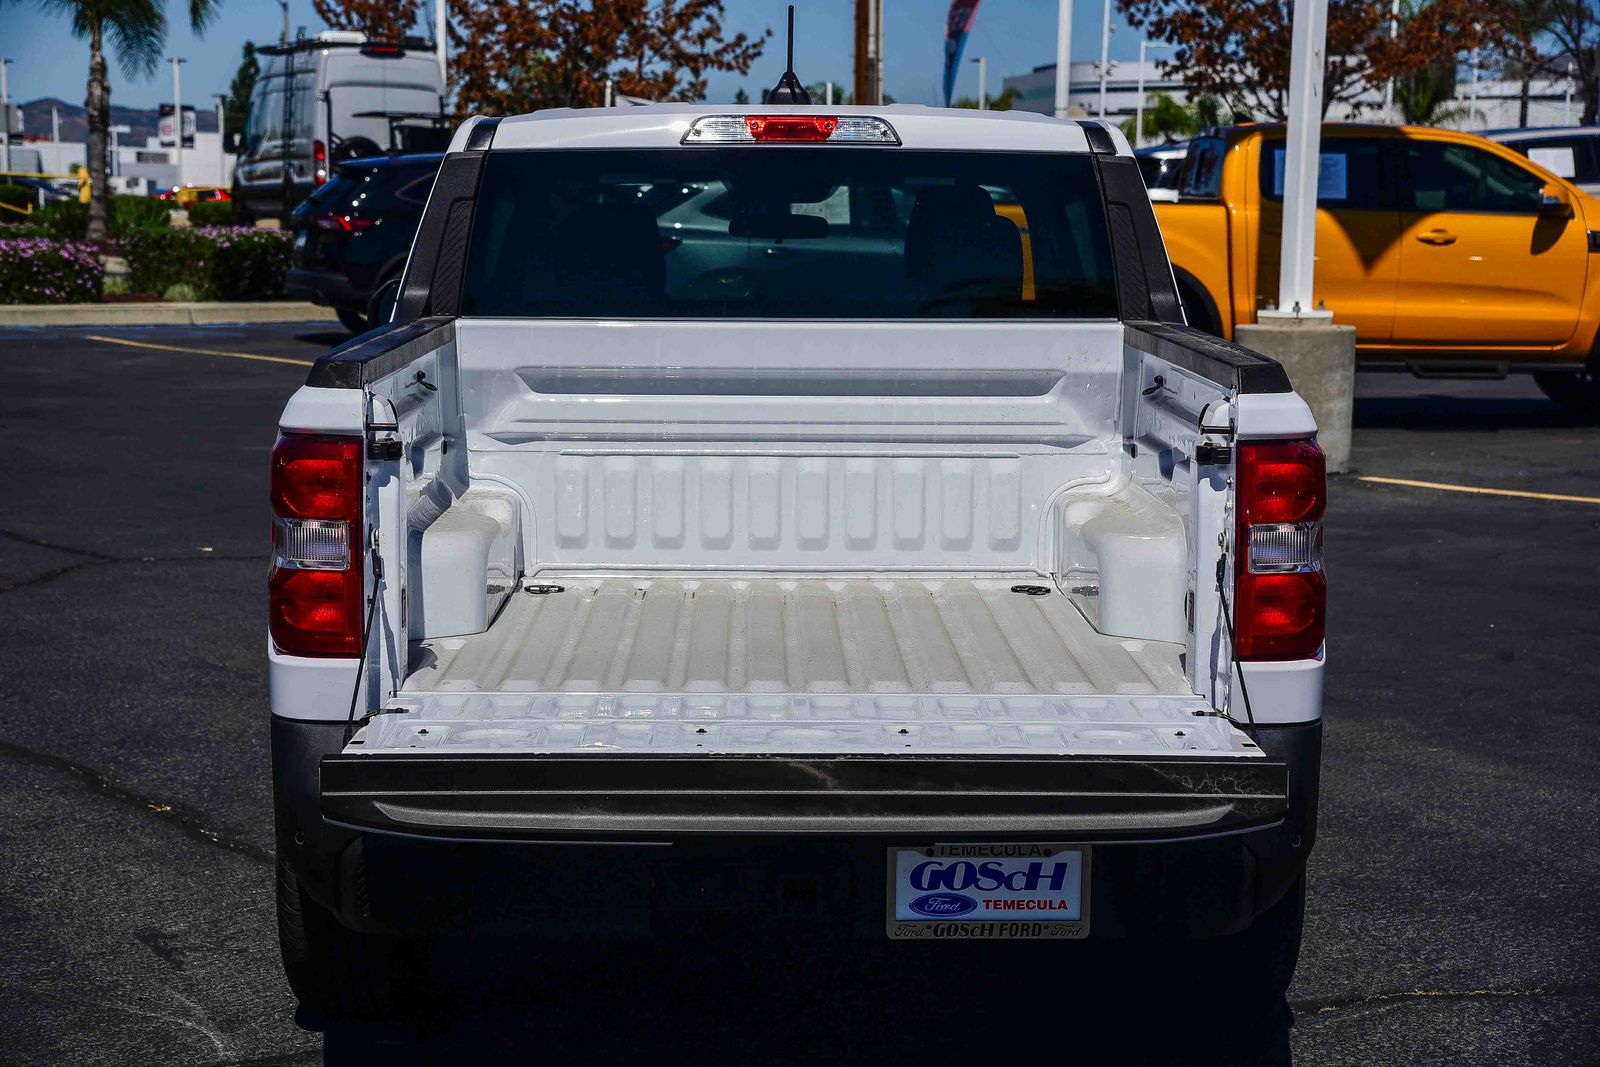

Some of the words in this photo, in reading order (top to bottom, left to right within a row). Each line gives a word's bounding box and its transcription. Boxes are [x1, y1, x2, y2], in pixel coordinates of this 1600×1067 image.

[940, 844, 1042, 857] TEMECULA
[924, 897, 961, 912] Ford
[983, 899, 1068, 910] TEMECULA
[895, 924, 925, 937] Ford
[999, 923, 1042, 937] FORD
[1050, 924, 1081, 937] Ford
